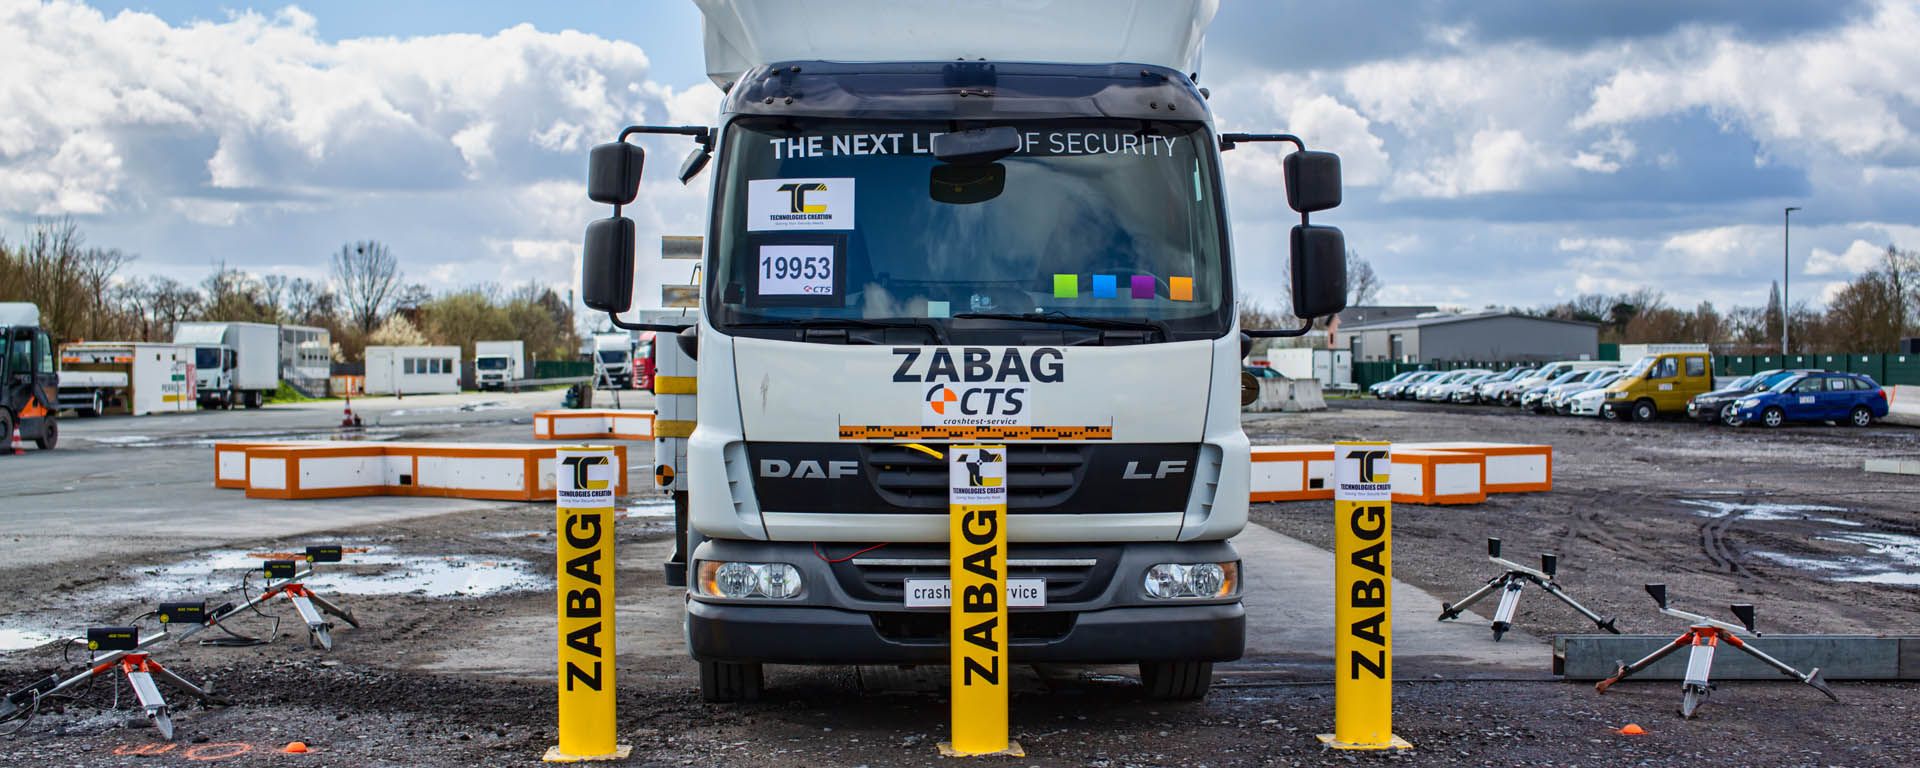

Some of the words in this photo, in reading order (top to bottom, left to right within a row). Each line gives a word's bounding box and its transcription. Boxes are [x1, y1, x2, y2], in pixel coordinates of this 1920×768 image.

[770, 136, 824, 160] THE
[832, 133, 904, 156] NEXT
[1049, 132, 1177, 157] SECURITY
[762, 256, 831, 280] 19953
[892, 347, 1064, 384] ZABAG
[960, 387, 1024, 416] CTS
[943, 417, 1017, 425] crashtest-service
[760, 459, 858, 479] DAF
[1122, 460, 1187, 479] LF
[566, 513, 602, 692] ZABAG
[962, 510, 999, 686] ZABAG
[1351, 506, 1385, 680] ZABAG
